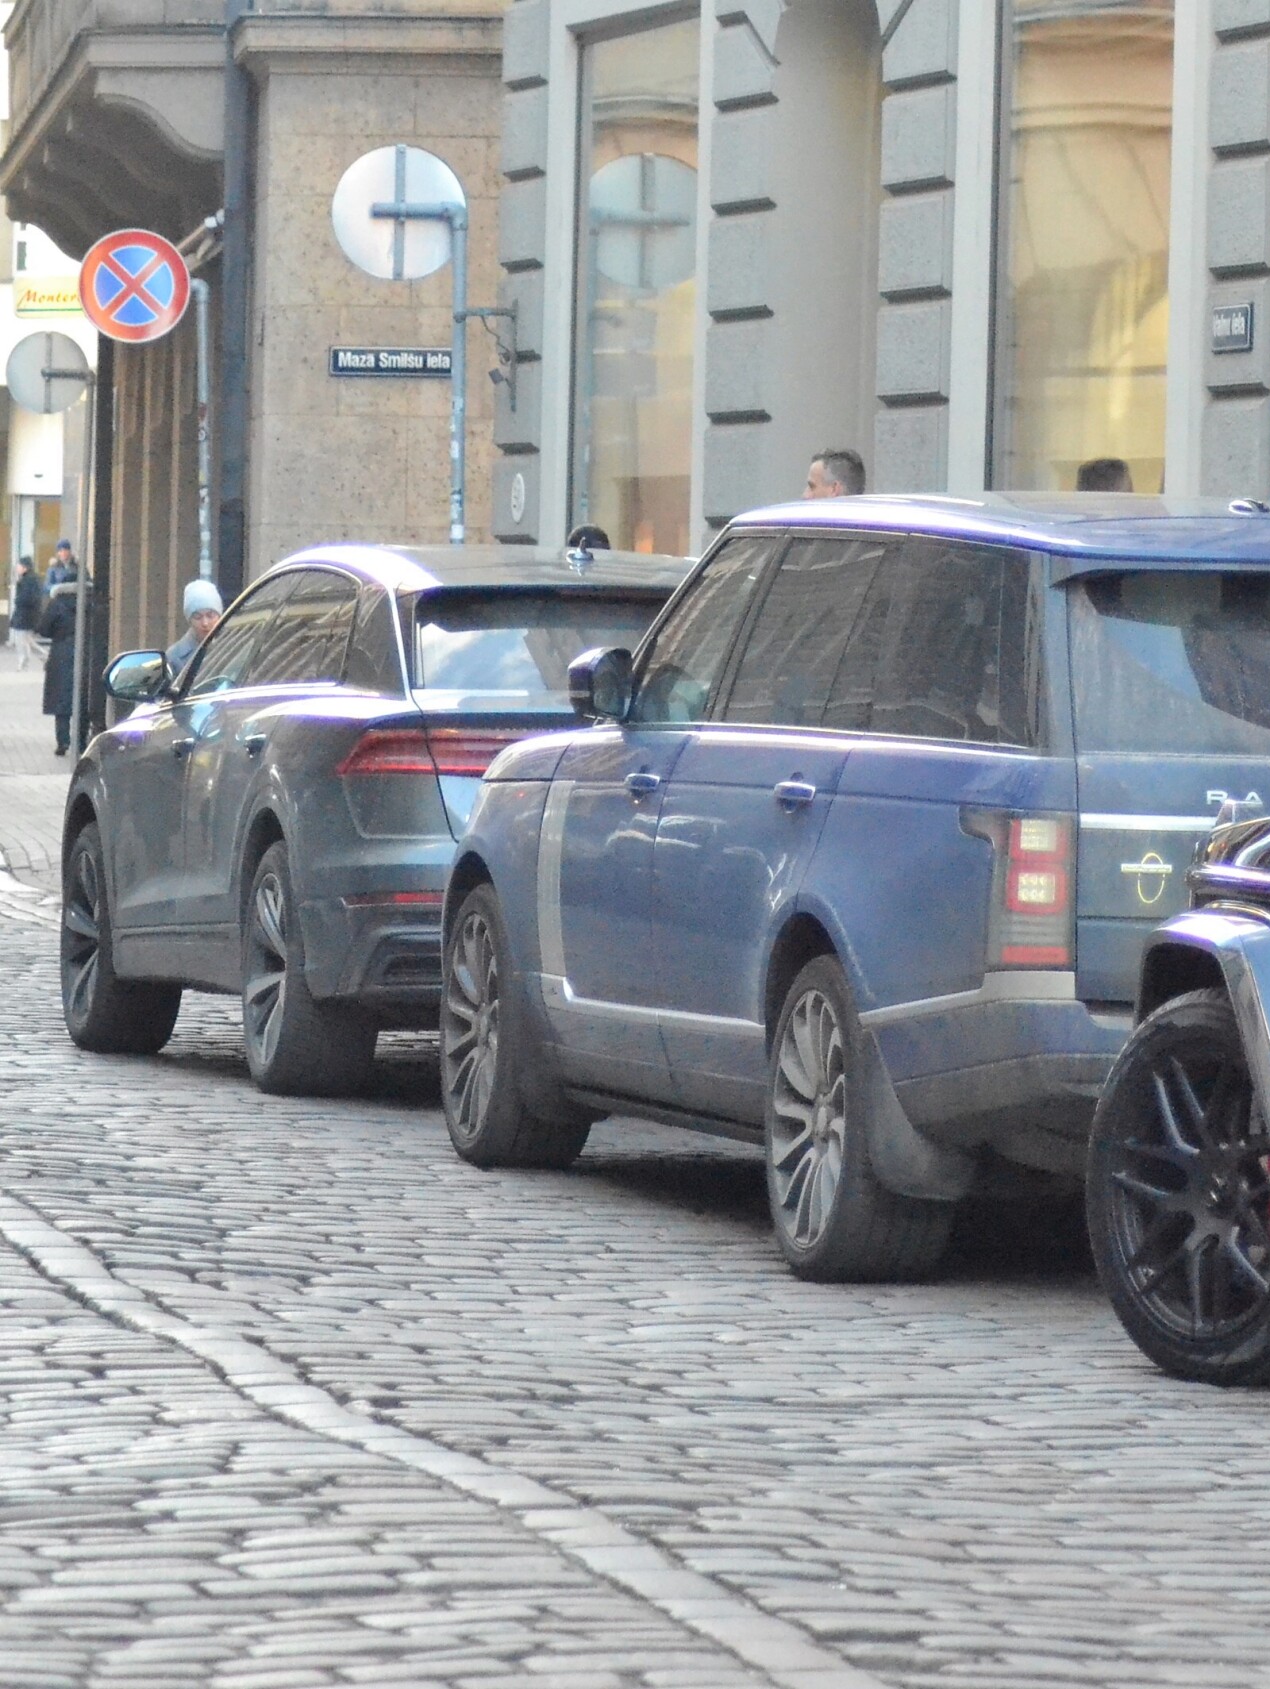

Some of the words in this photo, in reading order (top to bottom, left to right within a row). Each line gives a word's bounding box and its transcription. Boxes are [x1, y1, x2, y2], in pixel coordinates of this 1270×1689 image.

[17, 289, 80, 308] Monter
[338, 351, 375, 369] Mazā
[379, 351, 422, 369] Smilšu
[426, 352, 451, 369] iela
